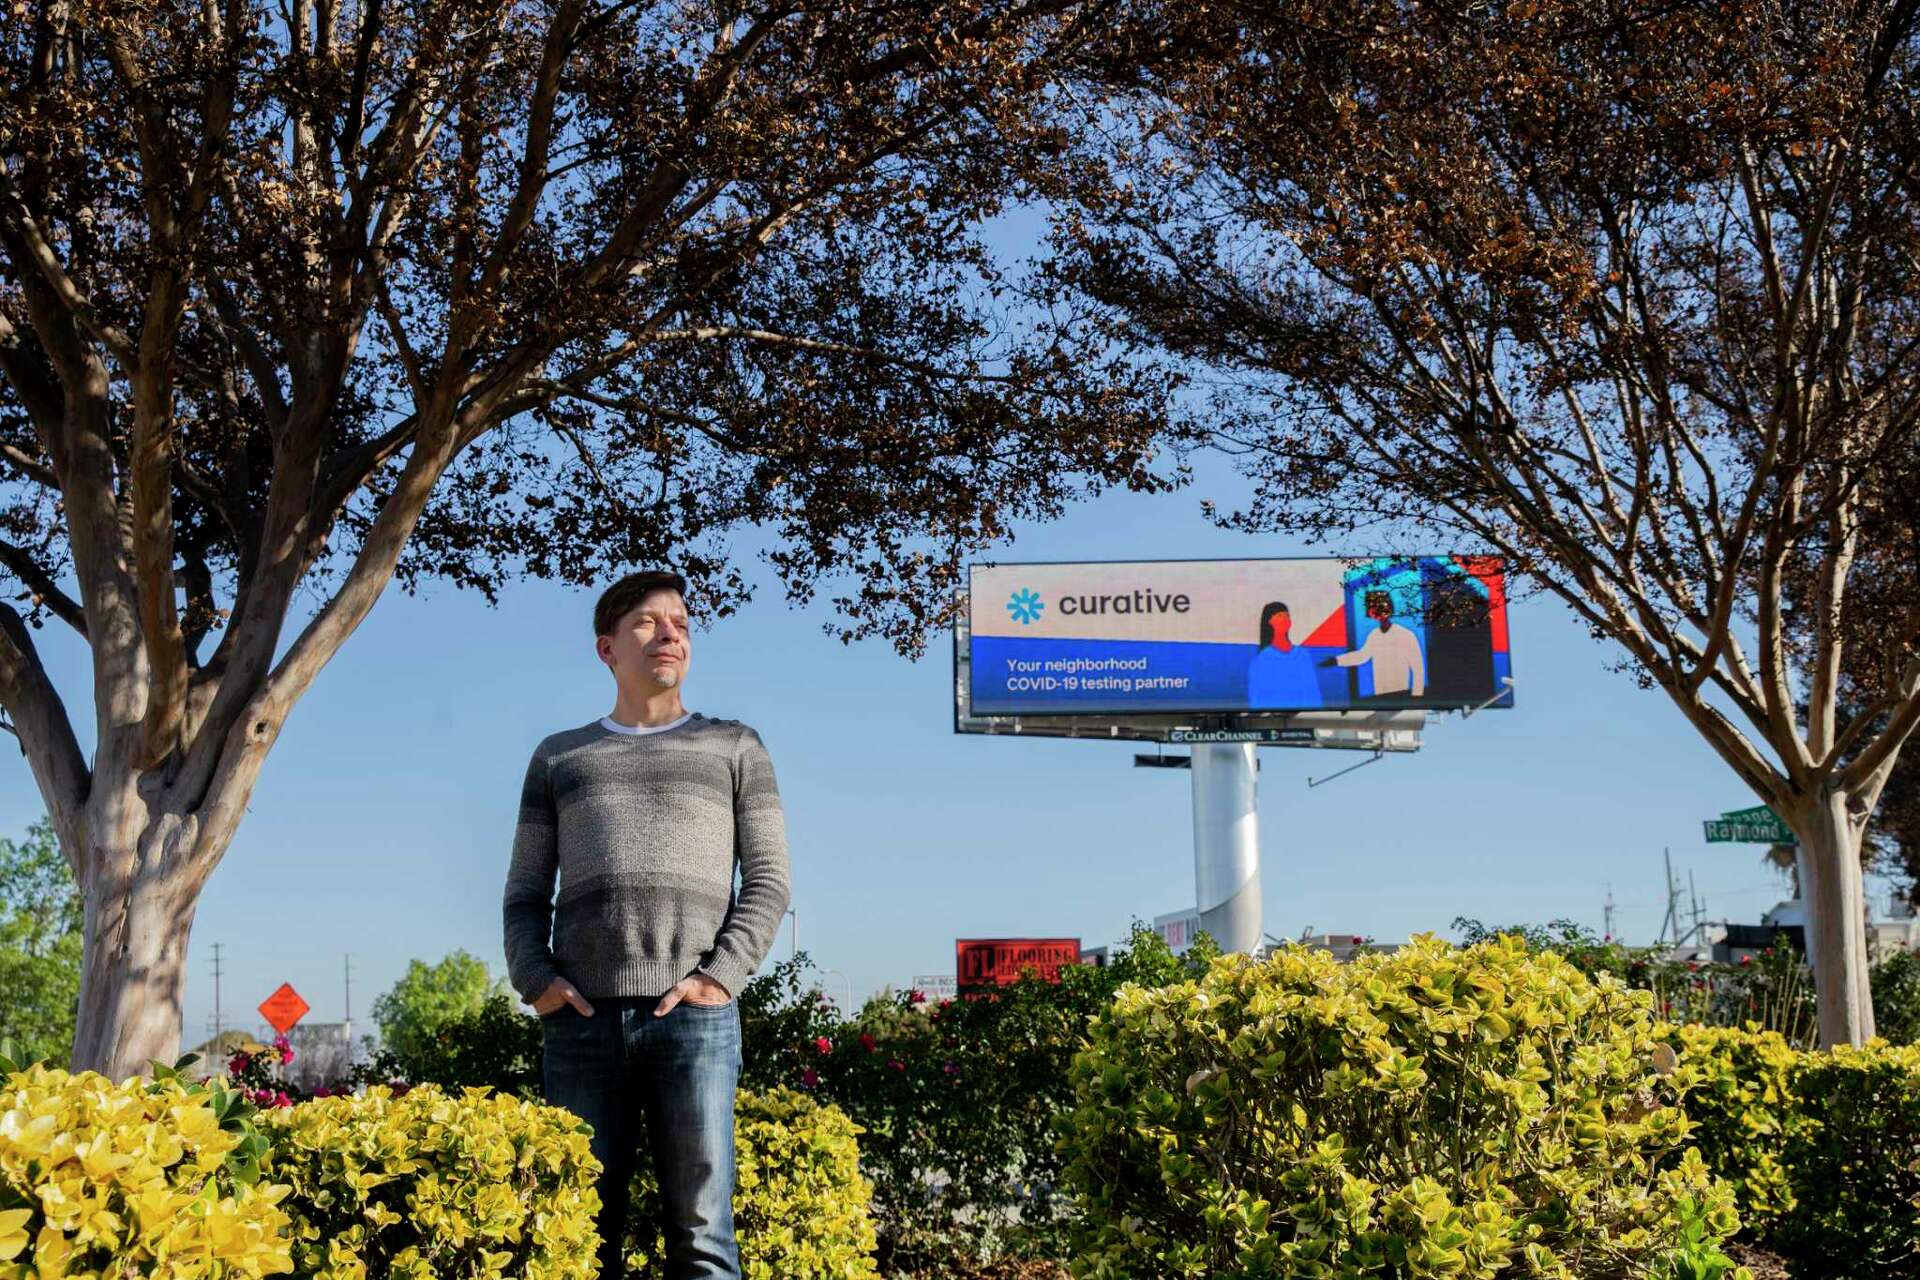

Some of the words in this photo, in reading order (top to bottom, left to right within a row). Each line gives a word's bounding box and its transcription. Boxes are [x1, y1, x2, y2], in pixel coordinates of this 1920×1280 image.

[1059, 588, 1191, 615] curative
[1007, 659, 1042, 672] Your
[1045, 657, 1147, 673] neighborhood
[1007, 677, 1078, 690] COVID-19
[1082, 676, 1131, 691] testing
[1135, 677, 1190, 691] partner
[1706, 821, 1780, 842] Raymond
[1000, 948, 1074, 964] FLOORING
